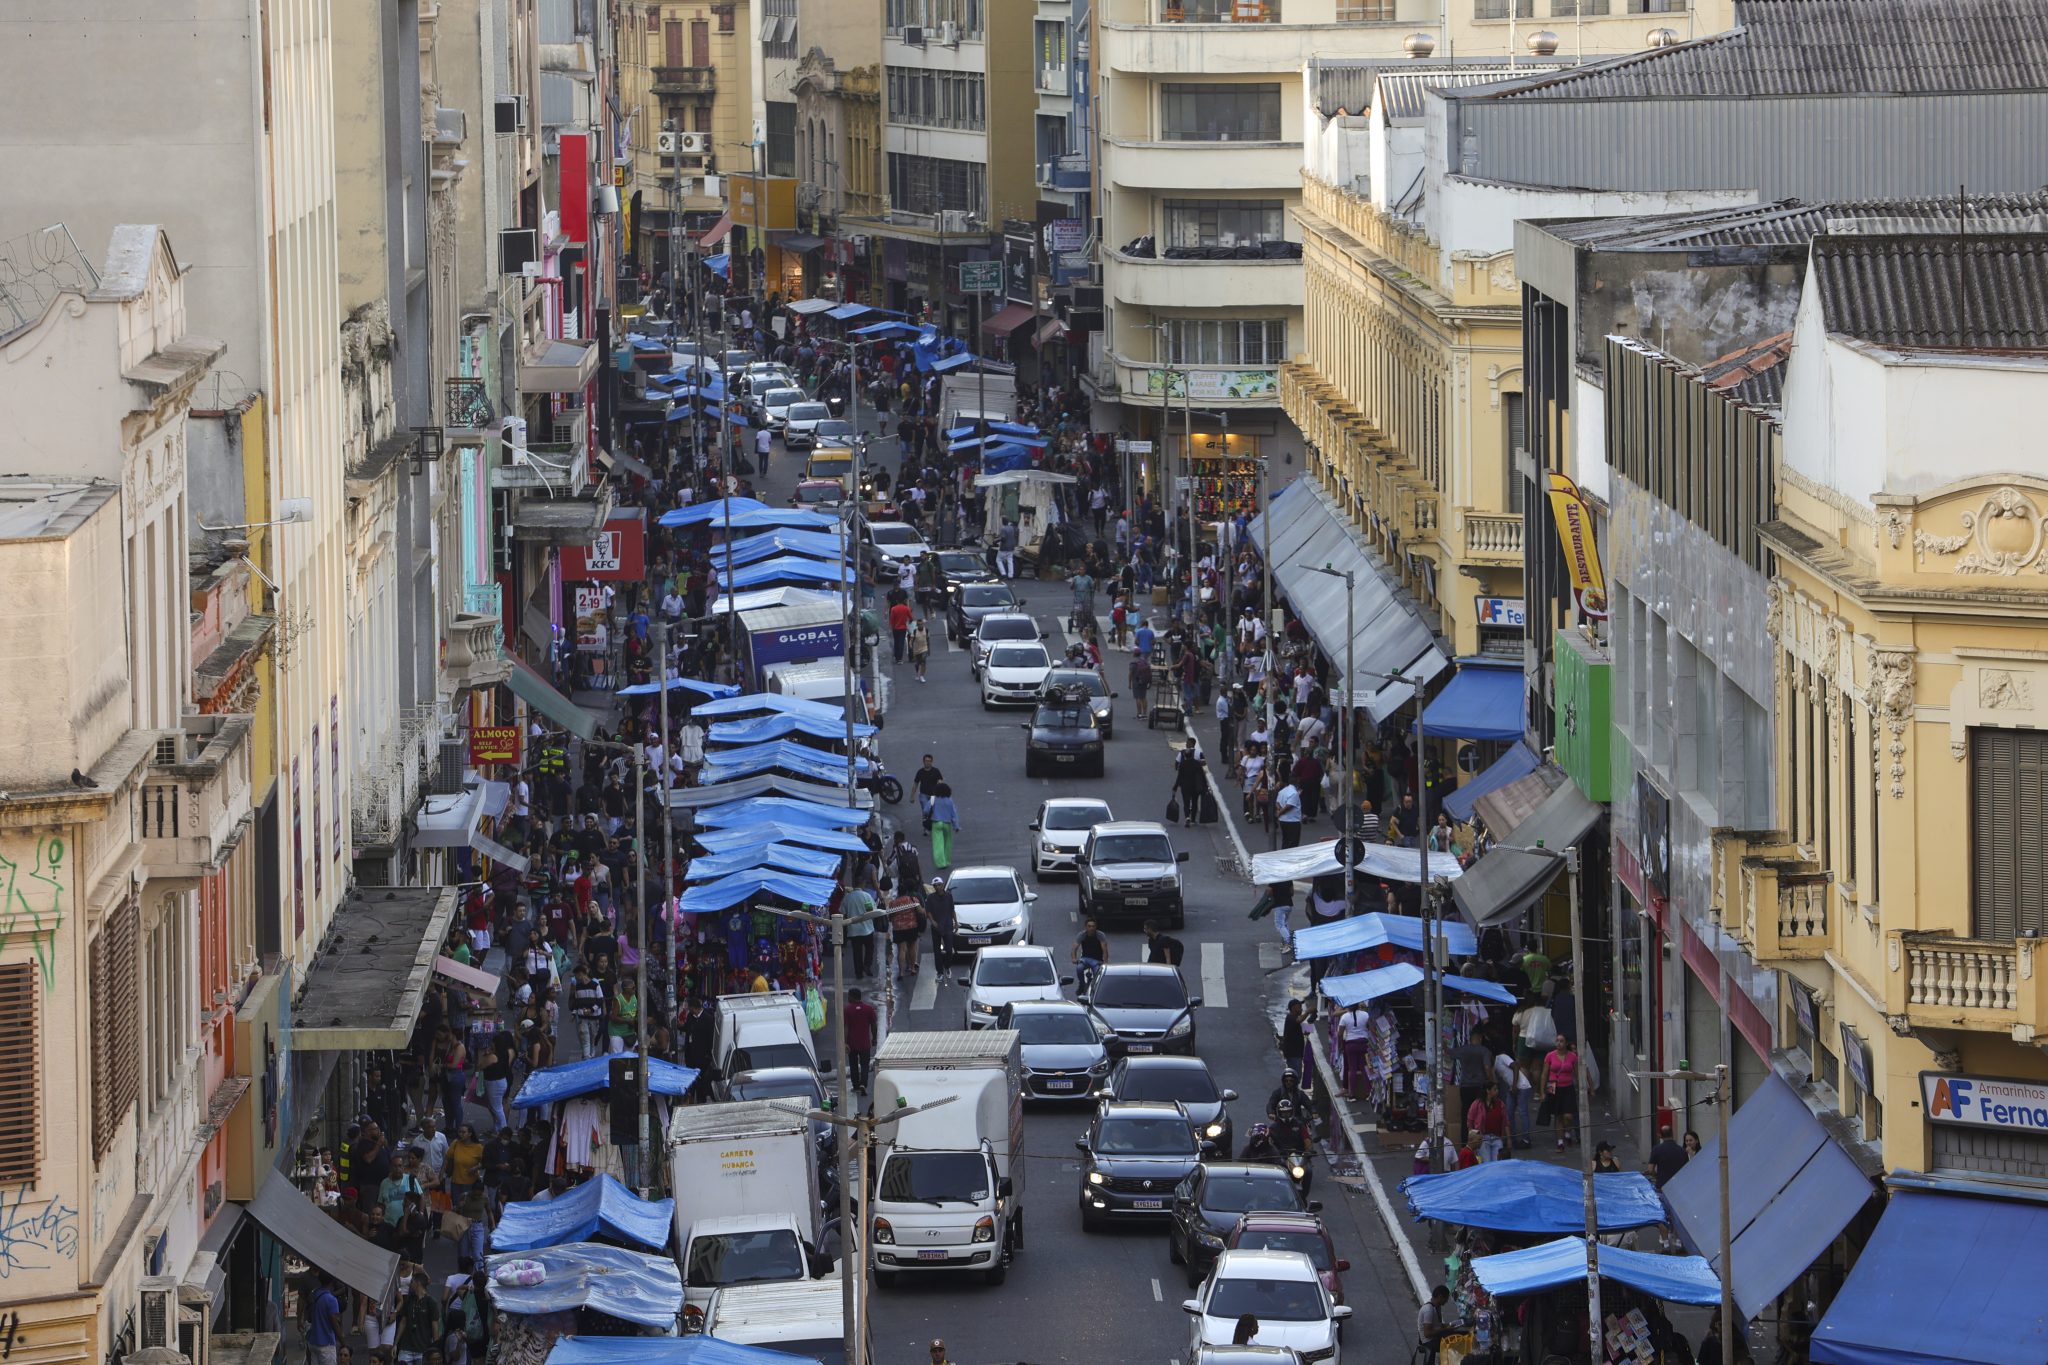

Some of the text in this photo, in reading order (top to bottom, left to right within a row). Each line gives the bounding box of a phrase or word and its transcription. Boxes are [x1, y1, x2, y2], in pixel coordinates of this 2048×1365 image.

[1566, 504, 1591, 584] RESTAURANTE
[592, 560, 614, 569] KFC
[1481, 599, 1503, 623] AF
[779, 630, 837, 643] GLOBAL
[474, 730, 516, 739] ALMOÇO
[1931, 1078, 2046, 1119] AF Armarinhos
[1980, 1097, 2048, 1128] Ferna
